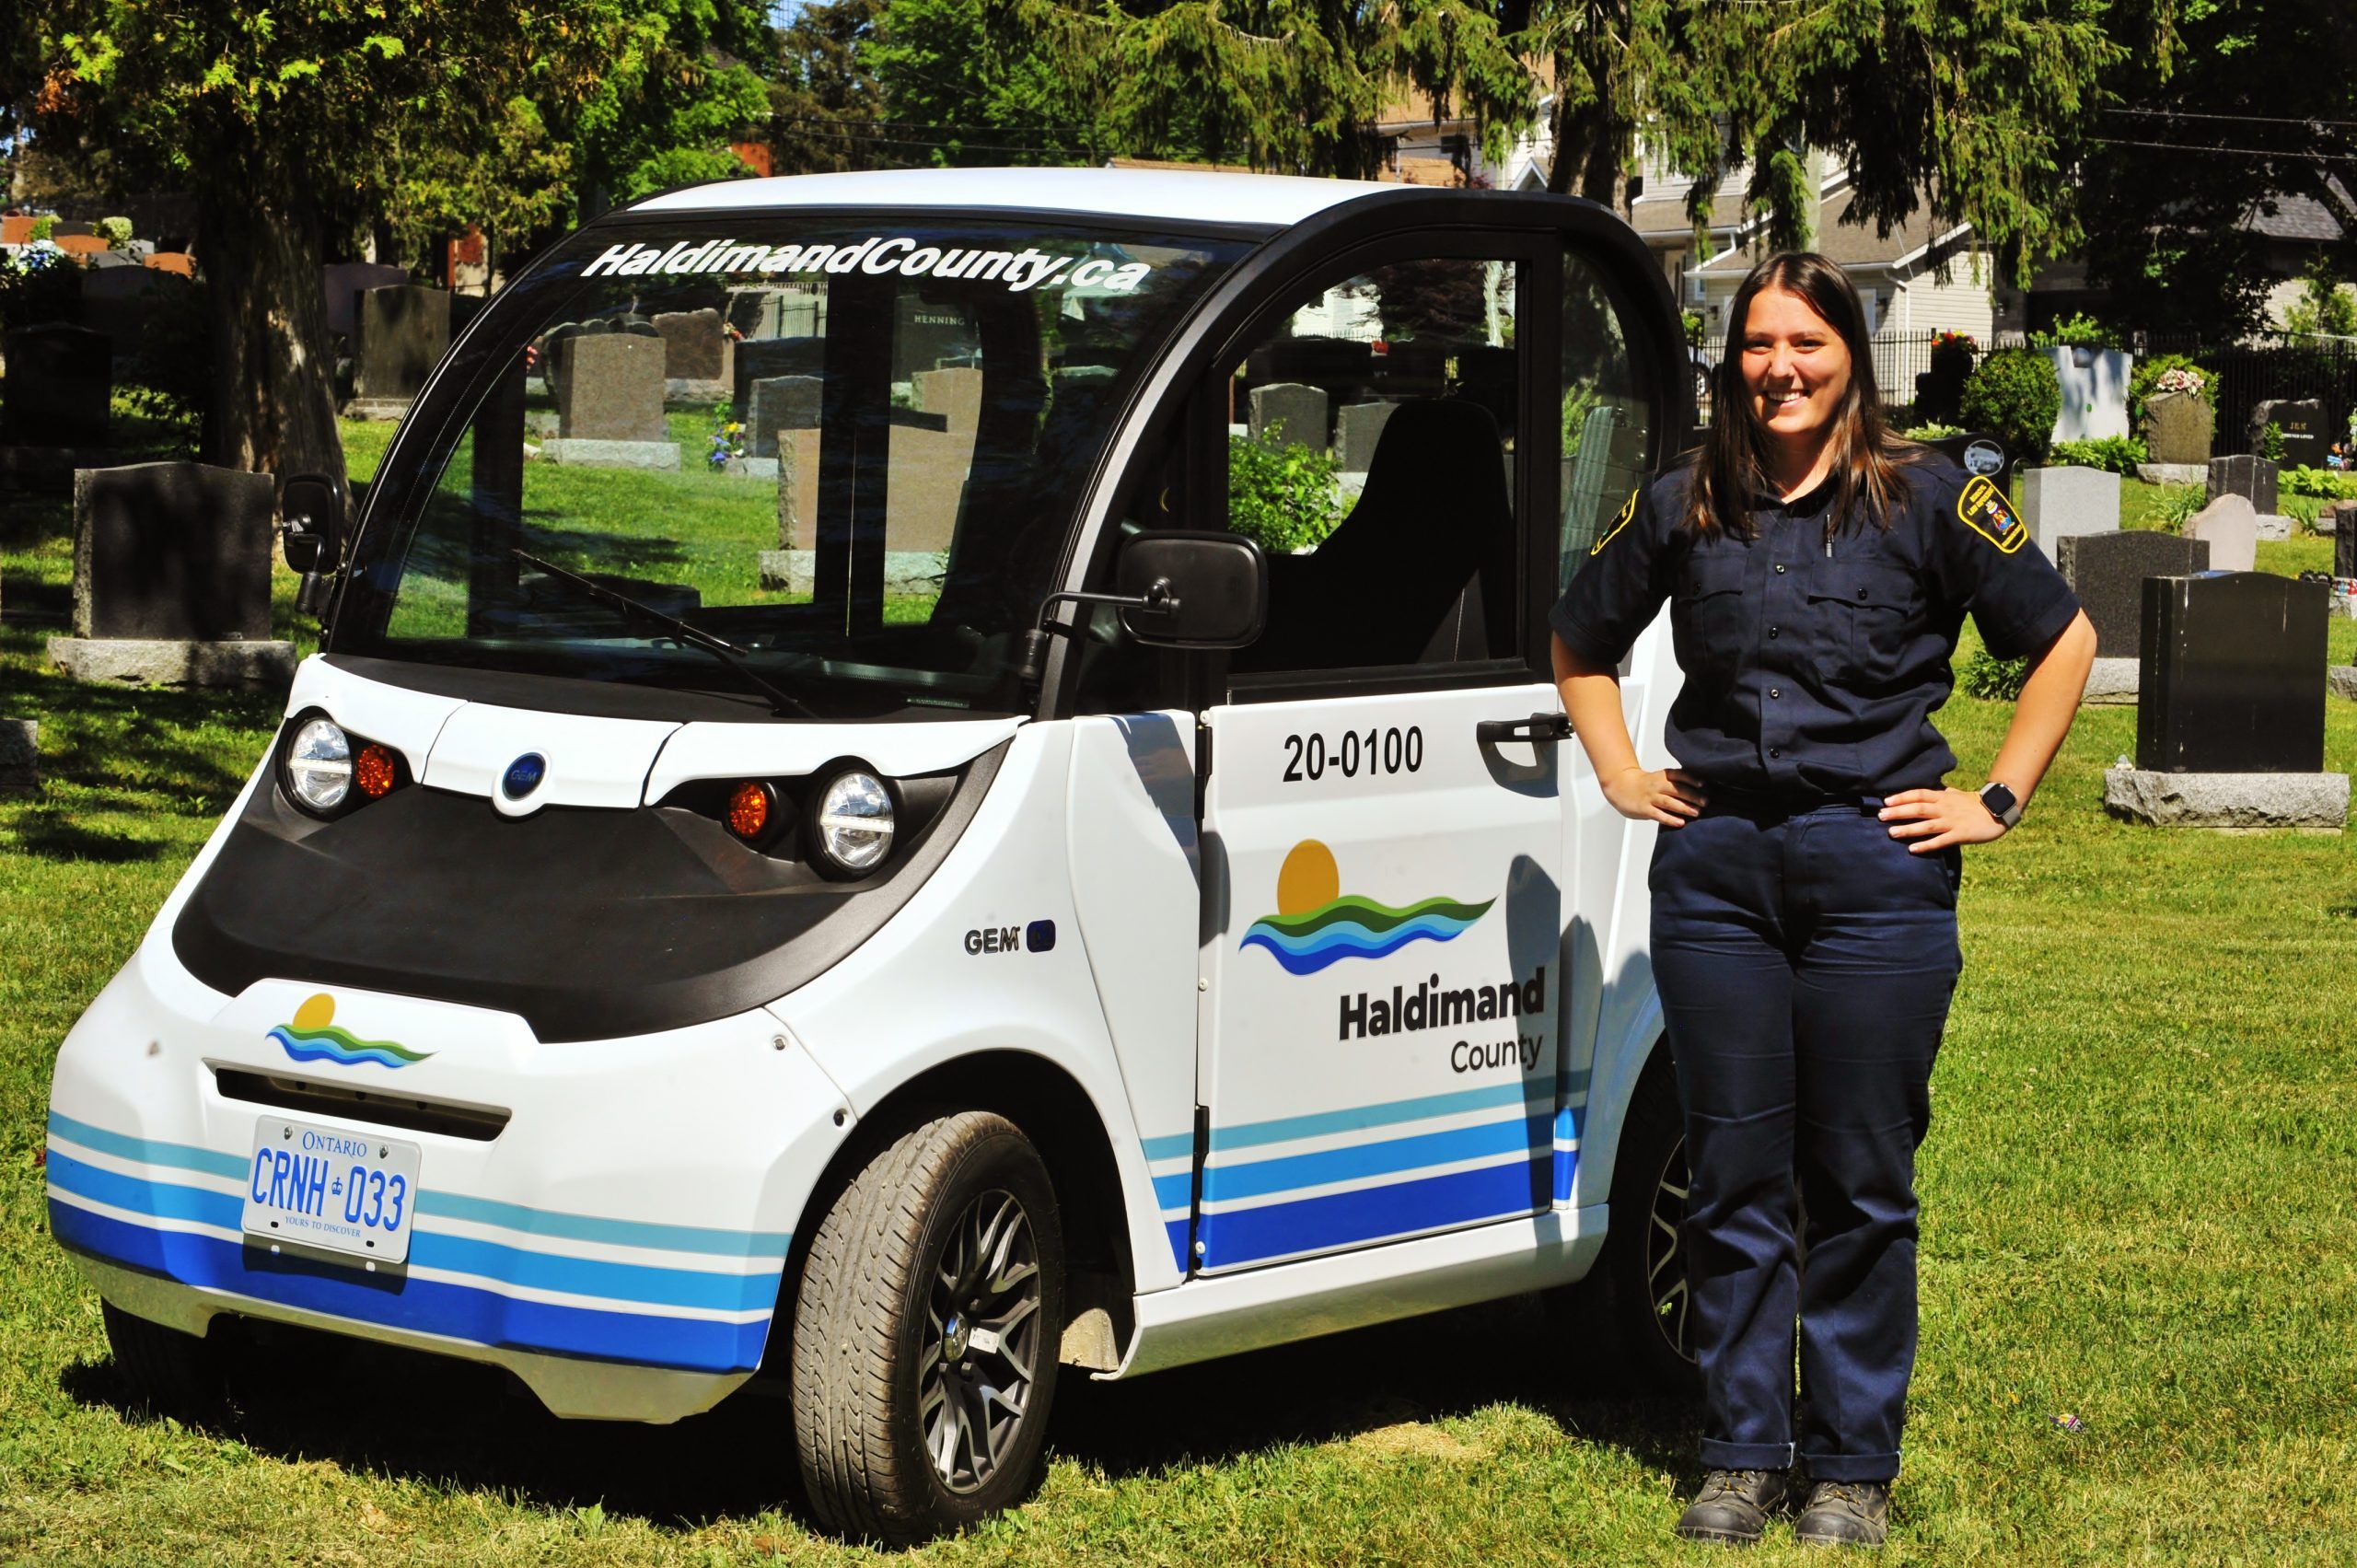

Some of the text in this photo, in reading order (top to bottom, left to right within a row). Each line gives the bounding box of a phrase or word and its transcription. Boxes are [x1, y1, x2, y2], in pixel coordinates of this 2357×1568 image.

[580, 238, 1152, 292] HaldimandCounty.ca
[914, 314, 965, 326] HENNING
[1283, 726, 1423, 783] 20-0100
[511, 769, 538, 782] GEM
[964, 926, 1021, 956] GEM
[1339, 967, 1546, 1040] Haldimand
[1450, 1033, 1544, 1074] County
[302, 1131, 367, 1158] ONTARIO
[251, 1147, 407, 1232] CRNH 033
[284, 1215, 361, 1237] YOURS TO DISCOVER
